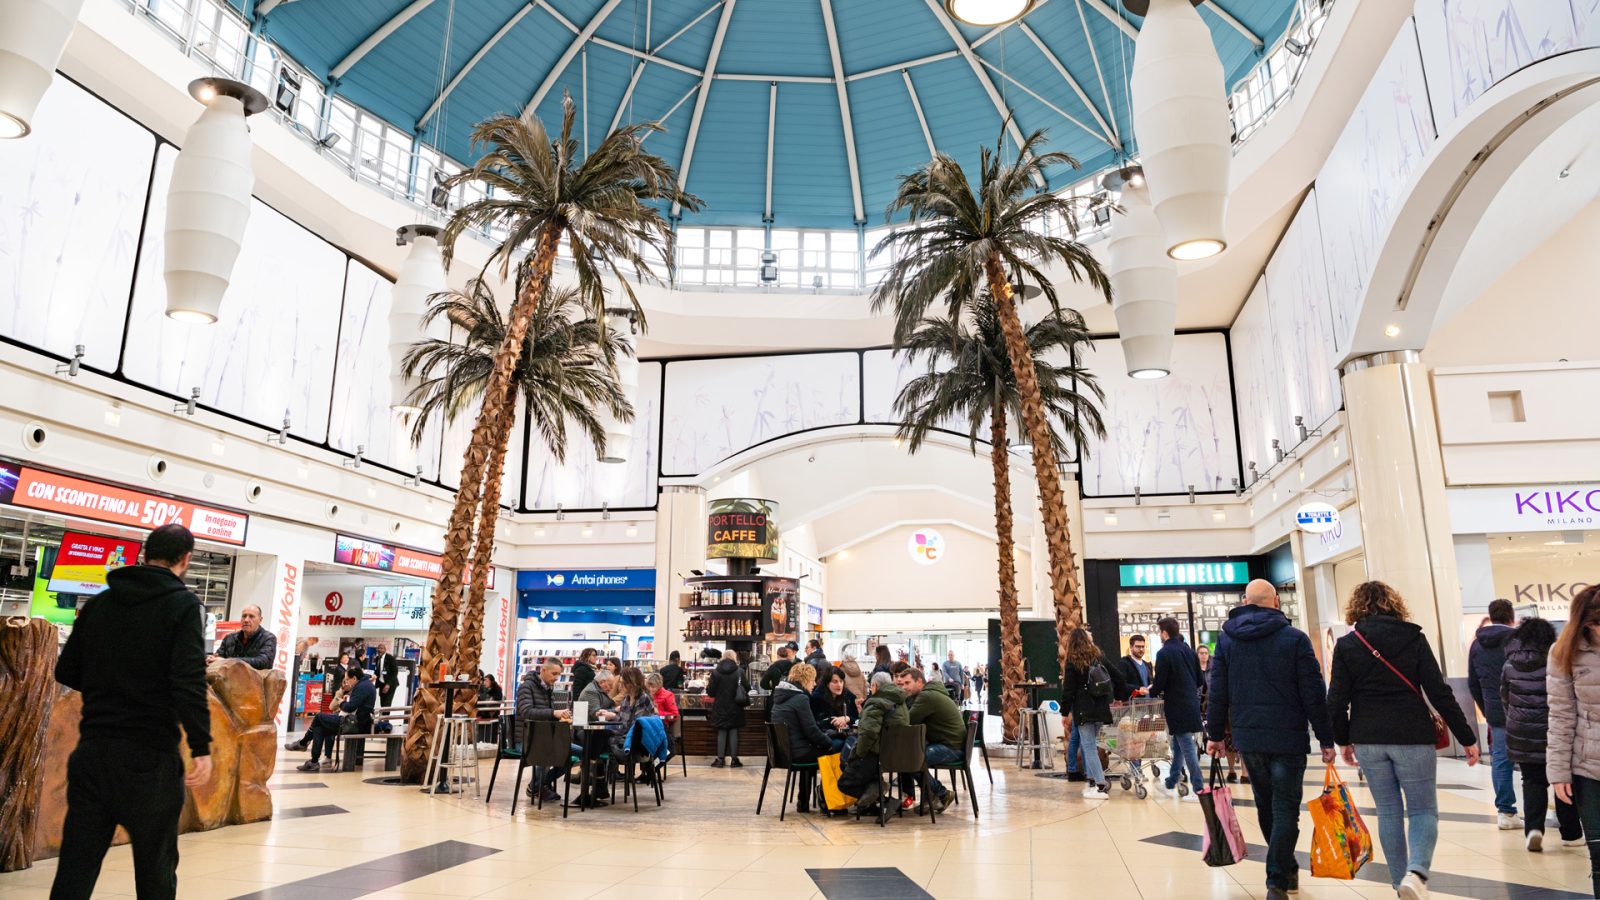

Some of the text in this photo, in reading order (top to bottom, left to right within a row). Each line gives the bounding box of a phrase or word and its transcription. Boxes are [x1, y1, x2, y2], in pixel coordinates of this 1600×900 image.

[27, 481, 184, 527] CON SCONTI FINO AL 50%
[1515, 489, 1600, 514] KIKO
[709, 514, 766, 527] PORTELLO
[713, 530, 757, 542] CAFFE
[571, 574, 596, 585] Antai
[1134, 563, 1235, 585] PORTOBELLO
[279, 563, 298, 627] World
[308, 614, 355, 625] Wi-Fi Free
[499, 598, 508, 643] World
